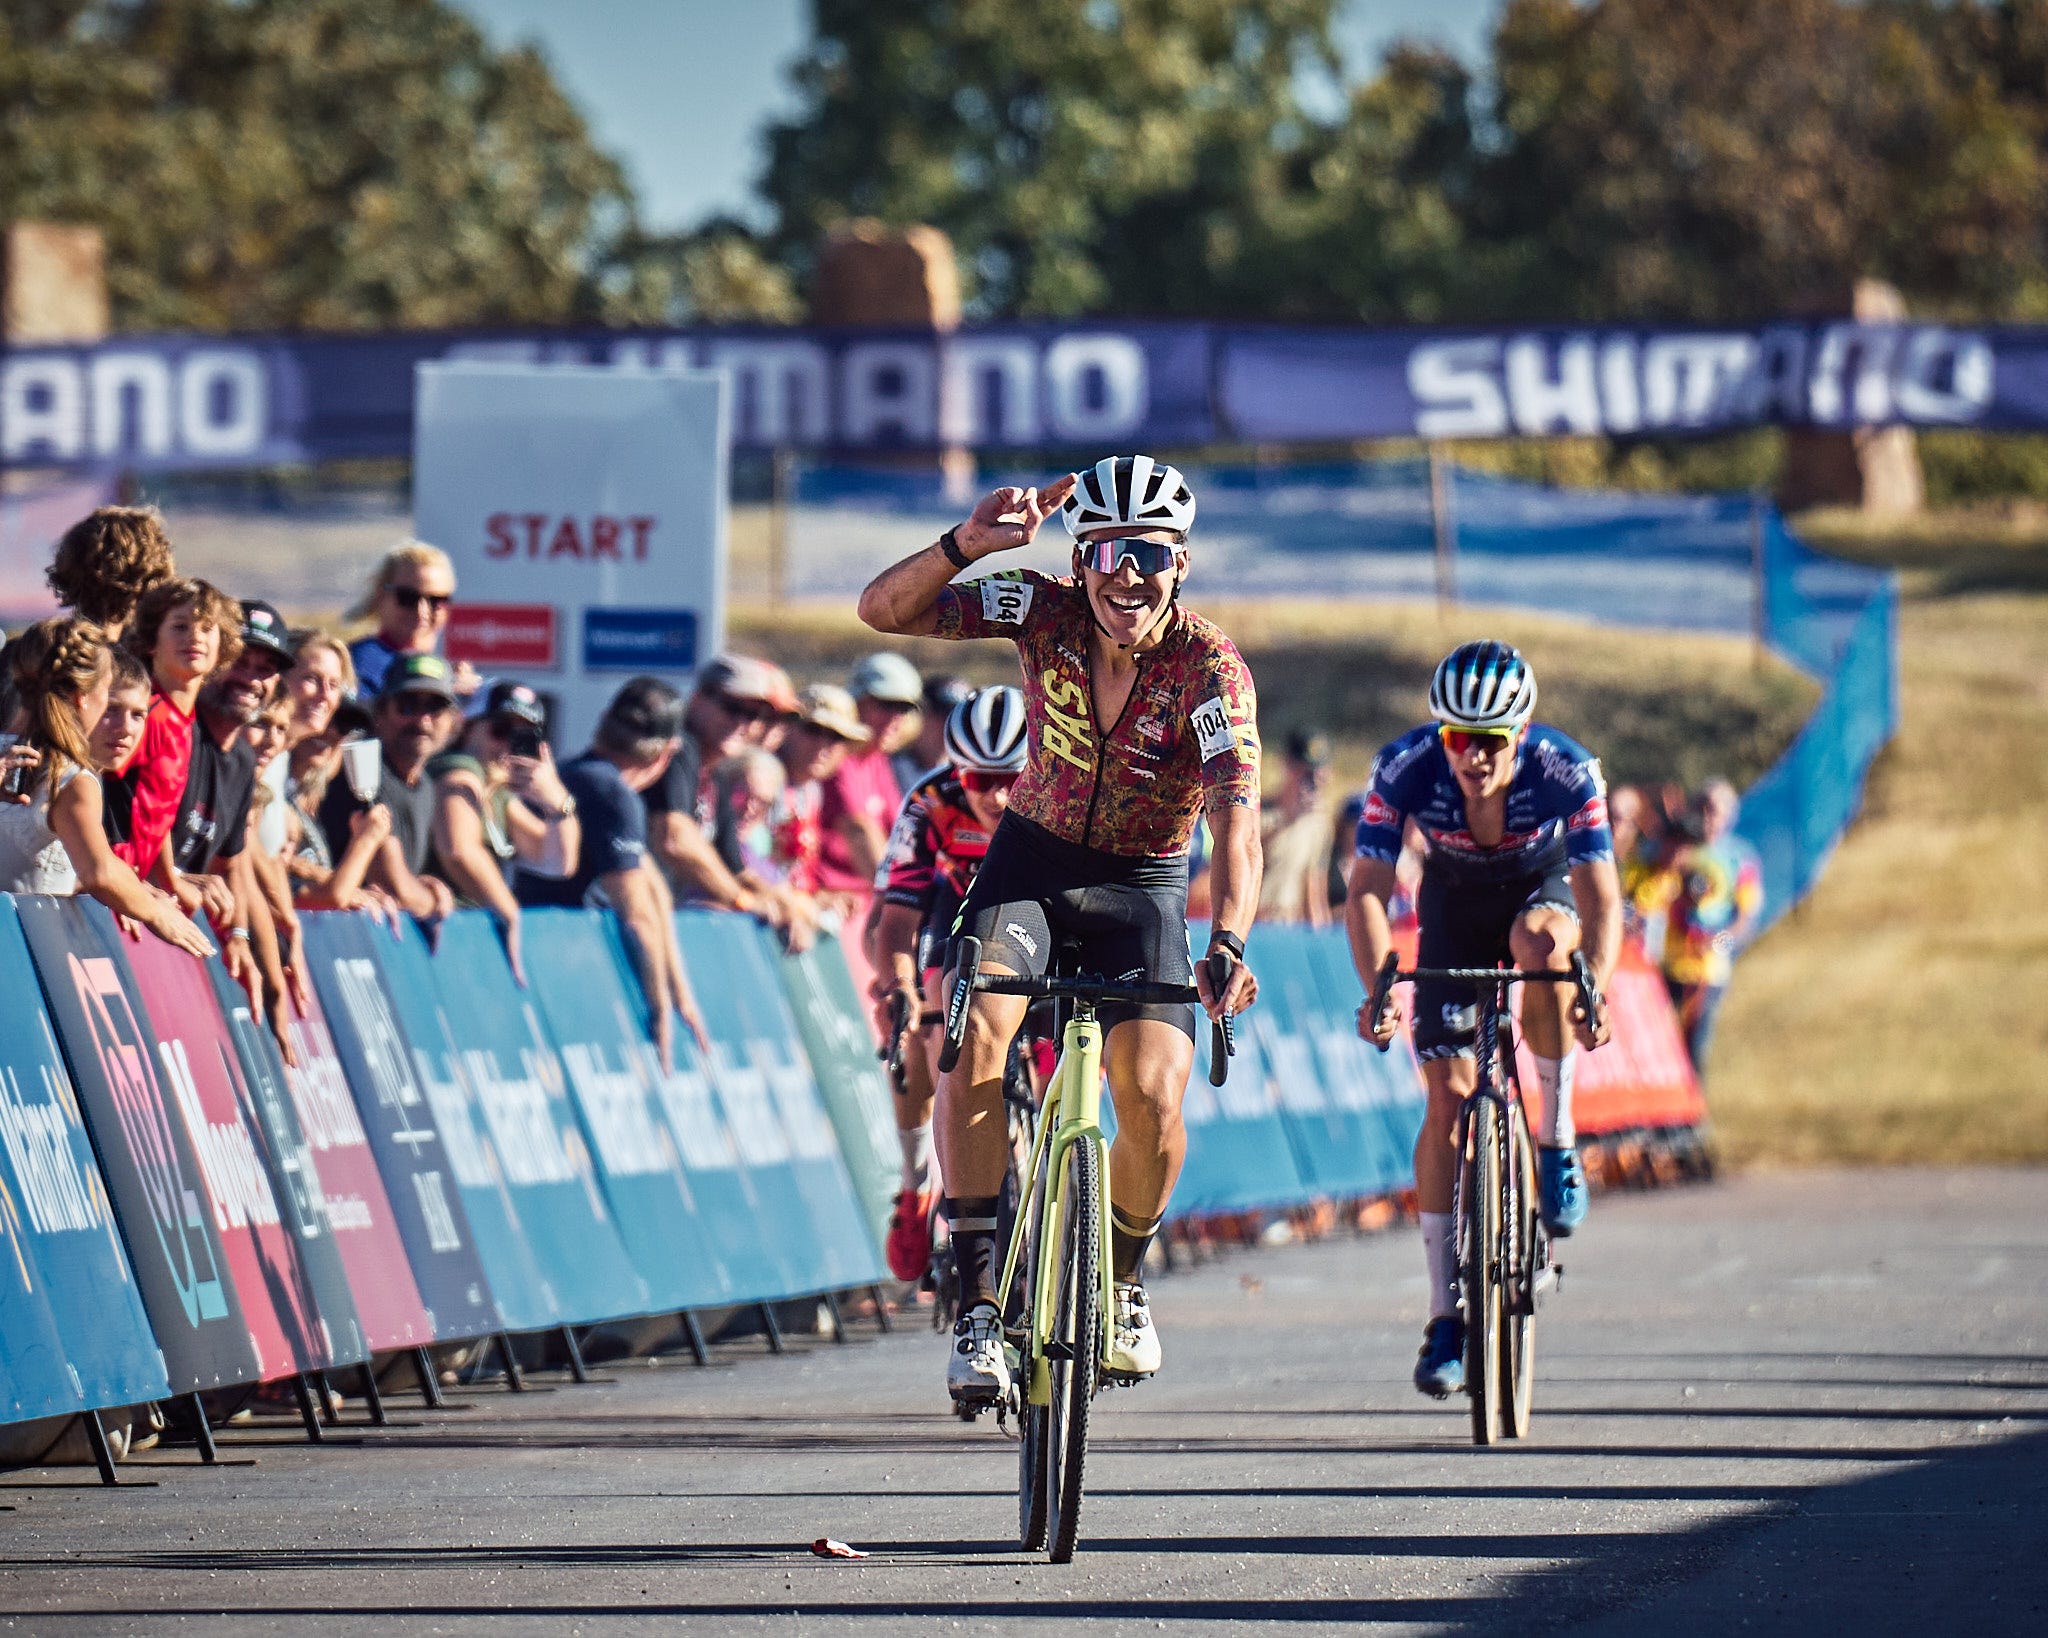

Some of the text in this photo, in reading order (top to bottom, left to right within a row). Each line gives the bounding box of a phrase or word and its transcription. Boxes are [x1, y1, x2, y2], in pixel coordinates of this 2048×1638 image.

[1406, 320, 1996, 440] SHIMANO
[484, 512, 656, 563] START
[997, 583, 1024, 622] 104
[1043, 668, 1093, 773] PAS
[1195, 706, 1229, 744] 104
[948, 978, 967, 1029] SRAM
